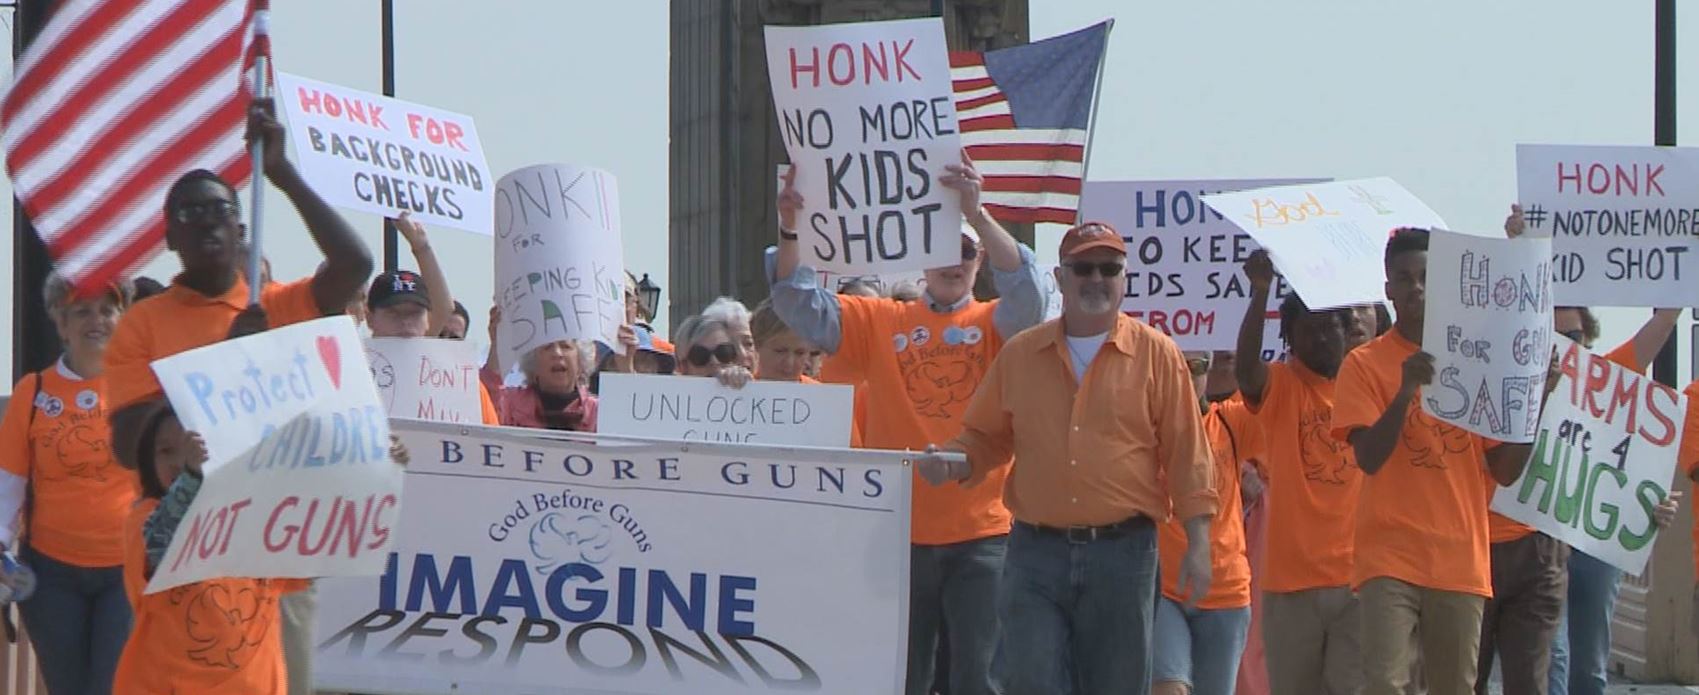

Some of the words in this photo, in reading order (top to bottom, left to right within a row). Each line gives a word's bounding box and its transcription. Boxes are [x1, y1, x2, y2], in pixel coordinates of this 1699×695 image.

[789, 38, 922, 89] HONK
[298, 87, 390, 132] HONK
[406, 113, 470, 152] FOR
[783, 108, 834, 149] NO
[859, 97, 955, 144] MORE
[308, 126, 484, 191] BACKGROUND
[825, 148, 931, 210] KIDS
[1557, 162, 1665, 197] HONK
[354, 172, 463, 220] CHECKS
[513, 232, 545, 253] FOR
[810, 203, 942, 265] SHOT
[1184, 234, 1252, 264] KEE
[1605, 246, 1690, 281] SHOT
[511, 293, 613, 352] SAFE
[1447, 324, 1491, 364] FOR
[184, 352, 317, 426] Protect
[632, 392, 811, 425] UNLOCKED
[1560, 343, 1680, 448] ARMS
[250, 405, 386, 472] CHILDRE
[1558, 419, 1592, 453] are
[1612, 434, 1632, 471] 4
[440, 440, 681, 482] BEFORE
[721, 461, 884, 499] GUNS
[1517, 428, 1668, 552] HUGS
[170, 498, 252, 573] NOT
[263, 494, 397, 559] GUNS
[488, 500, 530, 543] God
[531, 488, 604, 513] Before
[608, 503, 653, 554] Guns
[378, 551, 758, 637] IMAGINE
[317, 608, 823, 690] RESPOND
